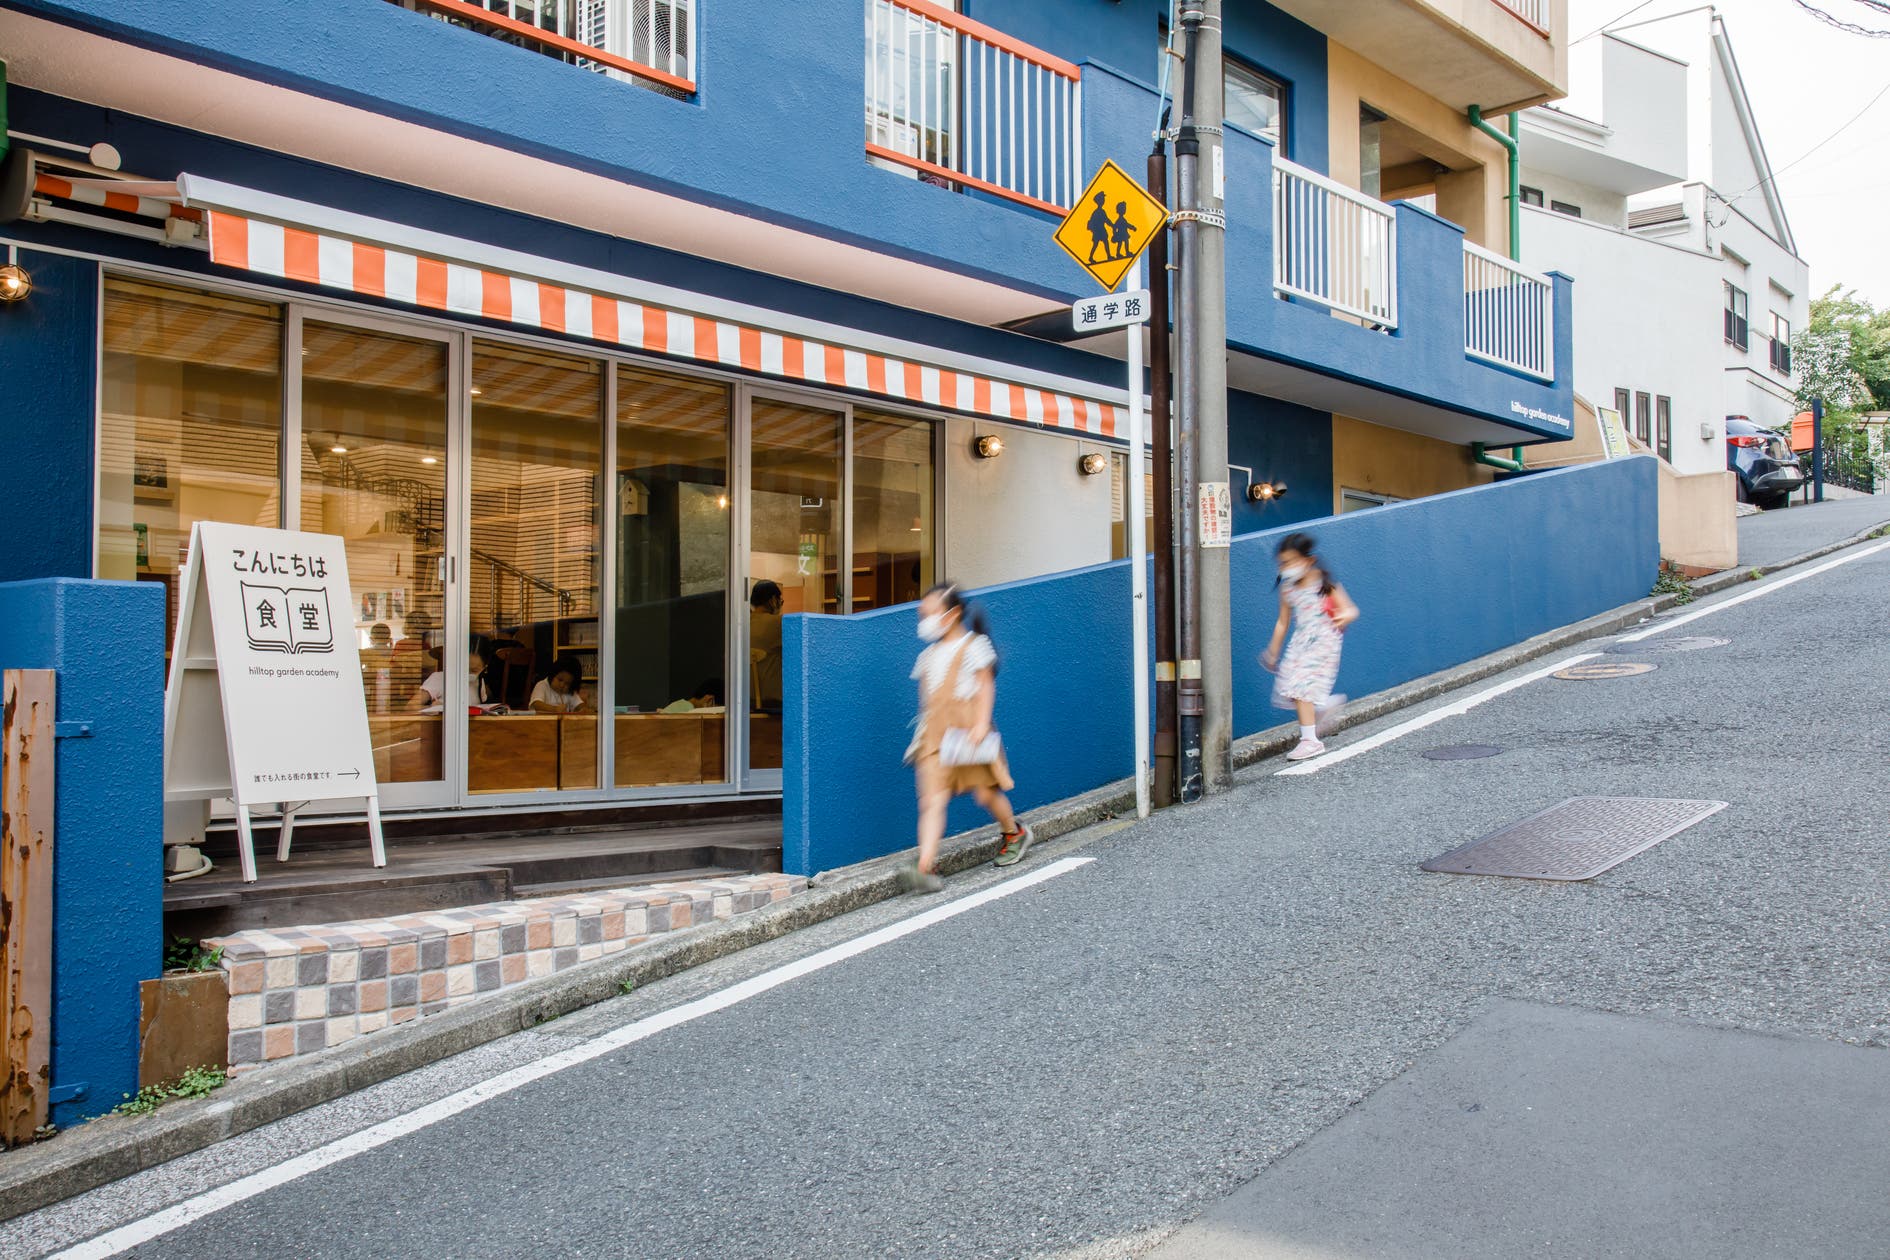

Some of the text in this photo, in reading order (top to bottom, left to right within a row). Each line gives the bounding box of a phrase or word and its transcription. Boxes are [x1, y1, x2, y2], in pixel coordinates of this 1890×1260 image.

[1081, 298, 1142, 324] 通学路
[232, 549, 328, 578] こんにちは
[256, 599, 320, 630] 食堂
[248, 666, 339, 679] hilltop garden academy
